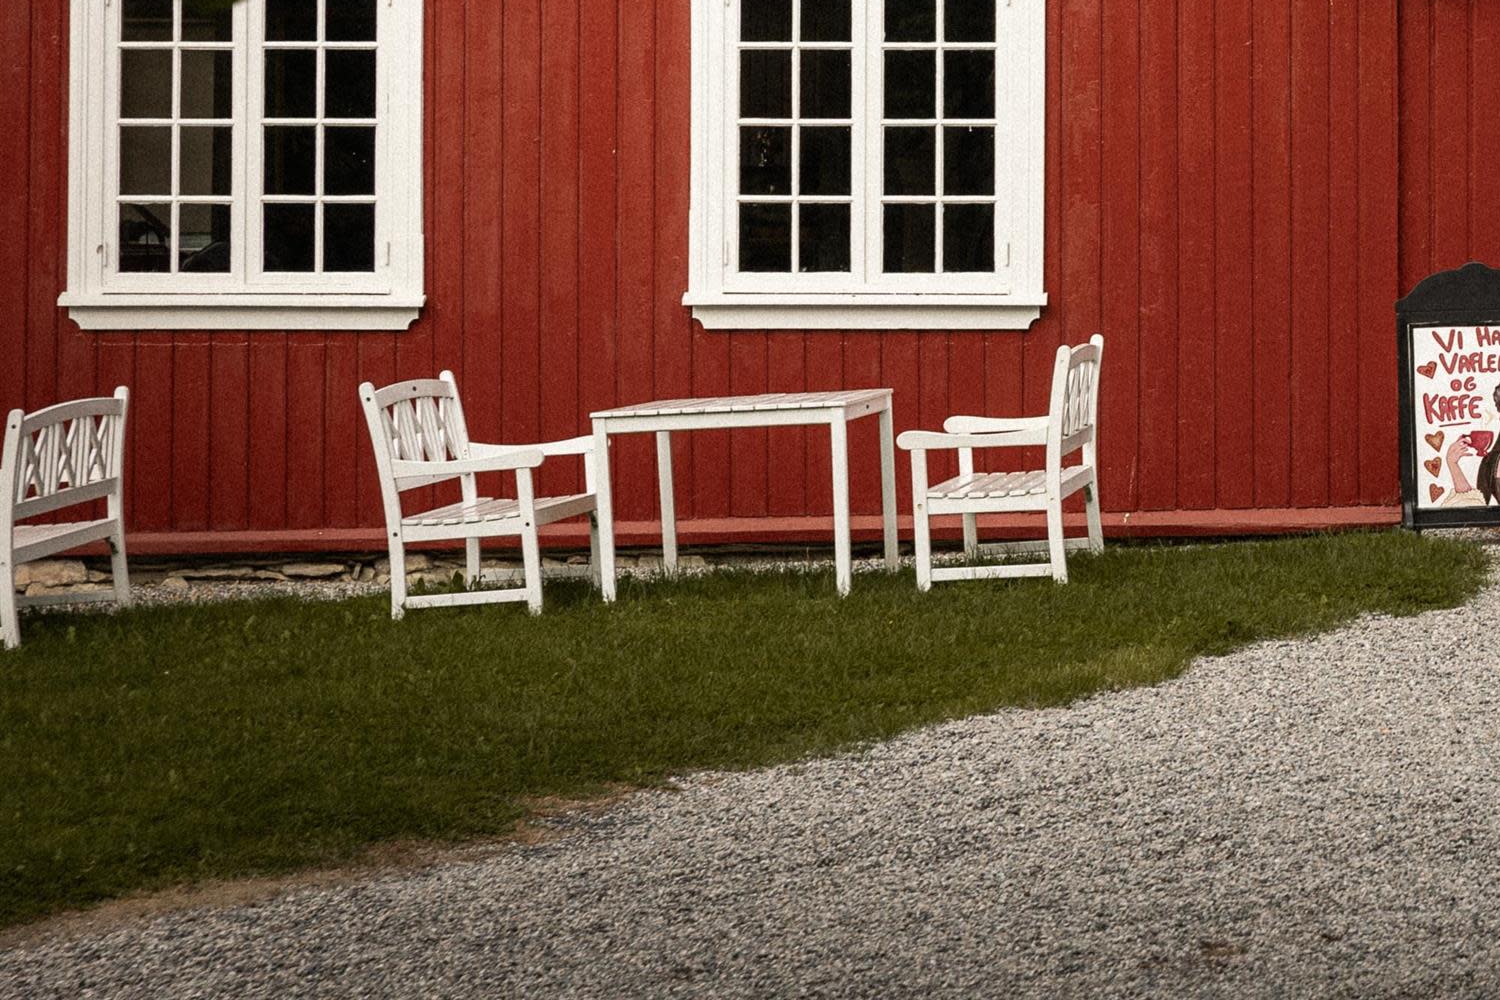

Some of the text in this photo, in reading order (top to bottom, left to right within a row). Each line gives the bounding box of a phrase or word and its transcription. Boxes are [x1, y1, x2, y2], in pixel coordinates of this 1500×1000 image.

[1432, 329, 1463, 353] VI
[1450, 376, 1477, 392] OG
[1423, 393, 1483, 424] KAFFE
